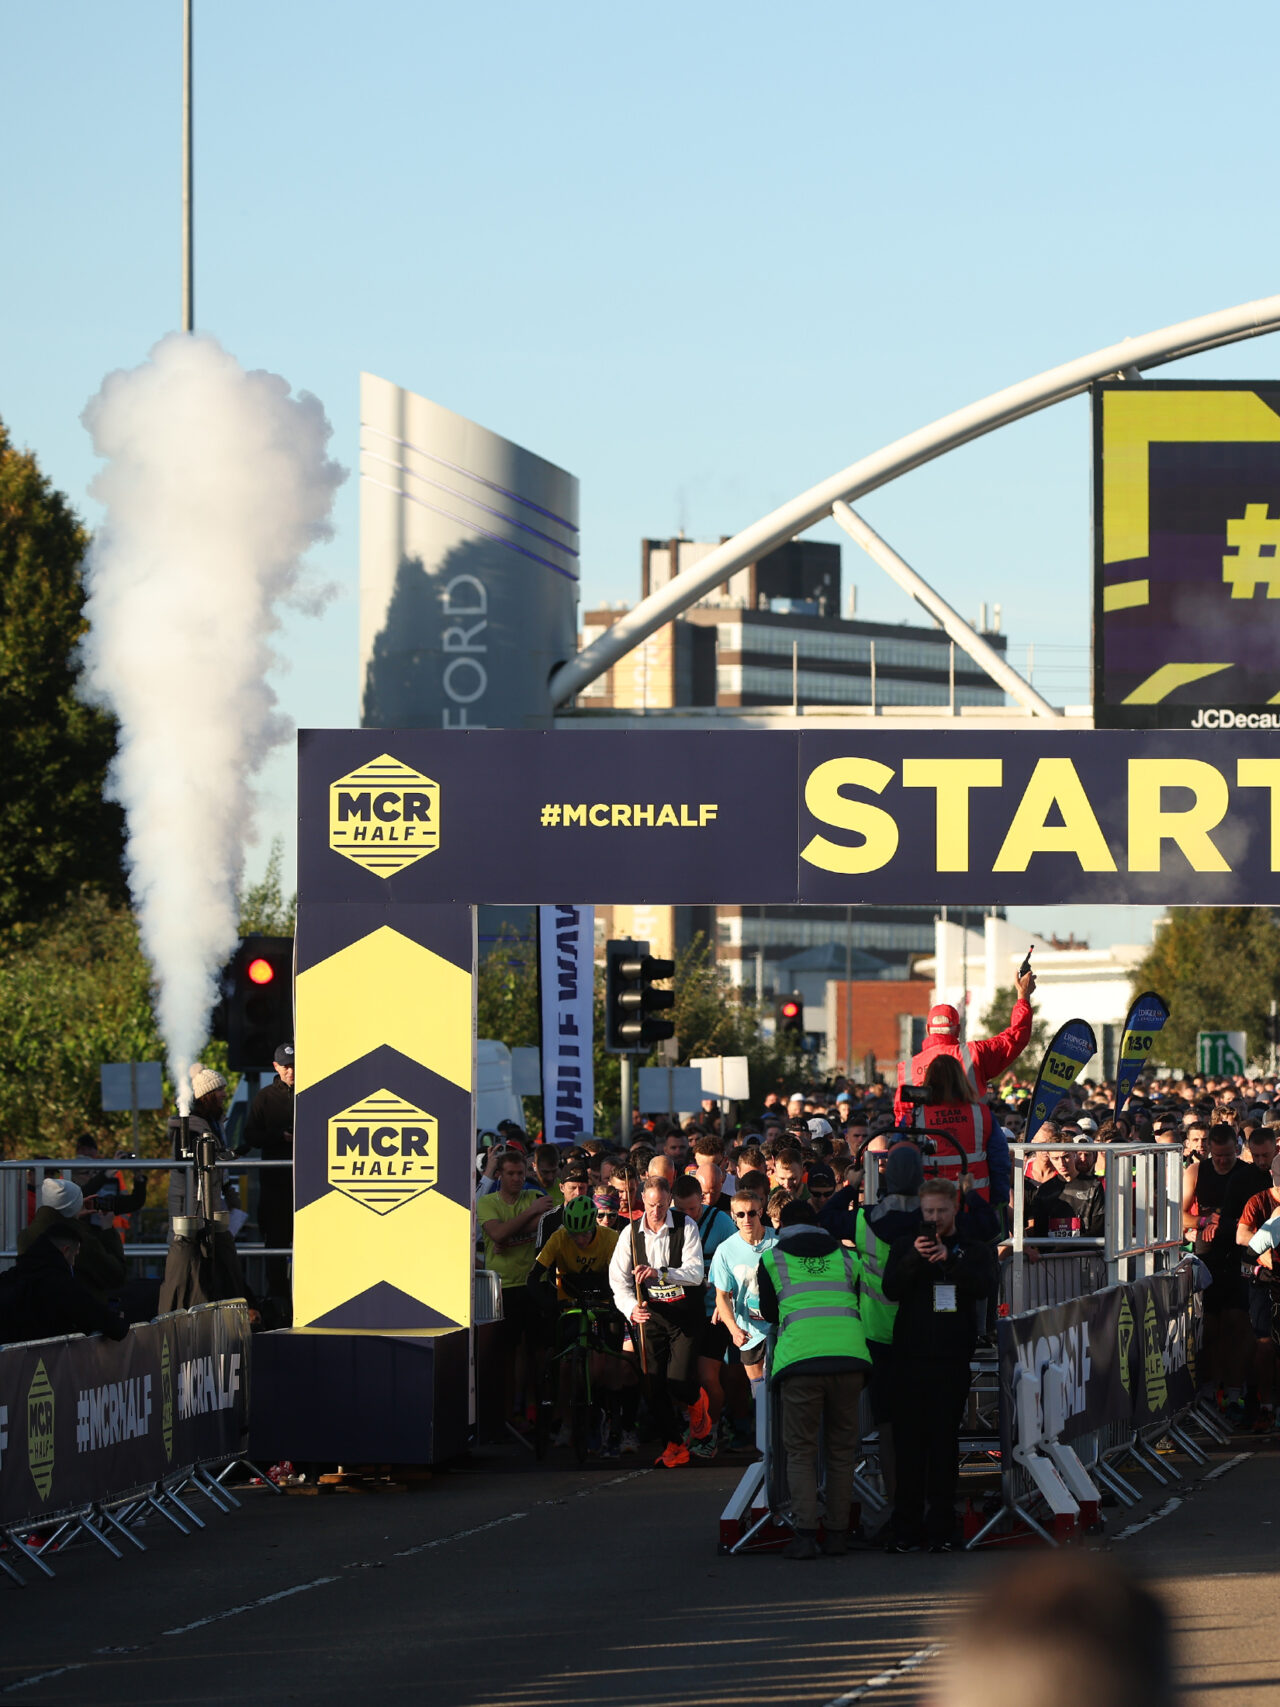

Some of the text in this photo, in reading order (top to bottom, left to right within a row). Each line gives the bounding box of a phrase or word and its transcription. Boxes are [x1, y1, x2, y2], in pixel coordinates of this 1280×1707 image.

[338, 792, 431, 822] MCR
[540, 803, 719, 828] #MCRHALF
[354, 826, 416, 842] HALF
[1128, 1035, 1153, 1051] 1:30
[1049, 1058, 1075, 1081] 1:20
[935, 1109, 962, 1117] TEAM
[930, 1117, 968, 1126] LEADER
[337, 1126, 429, 1157] MCR
[352, 1161, 415, 1177] HALF
